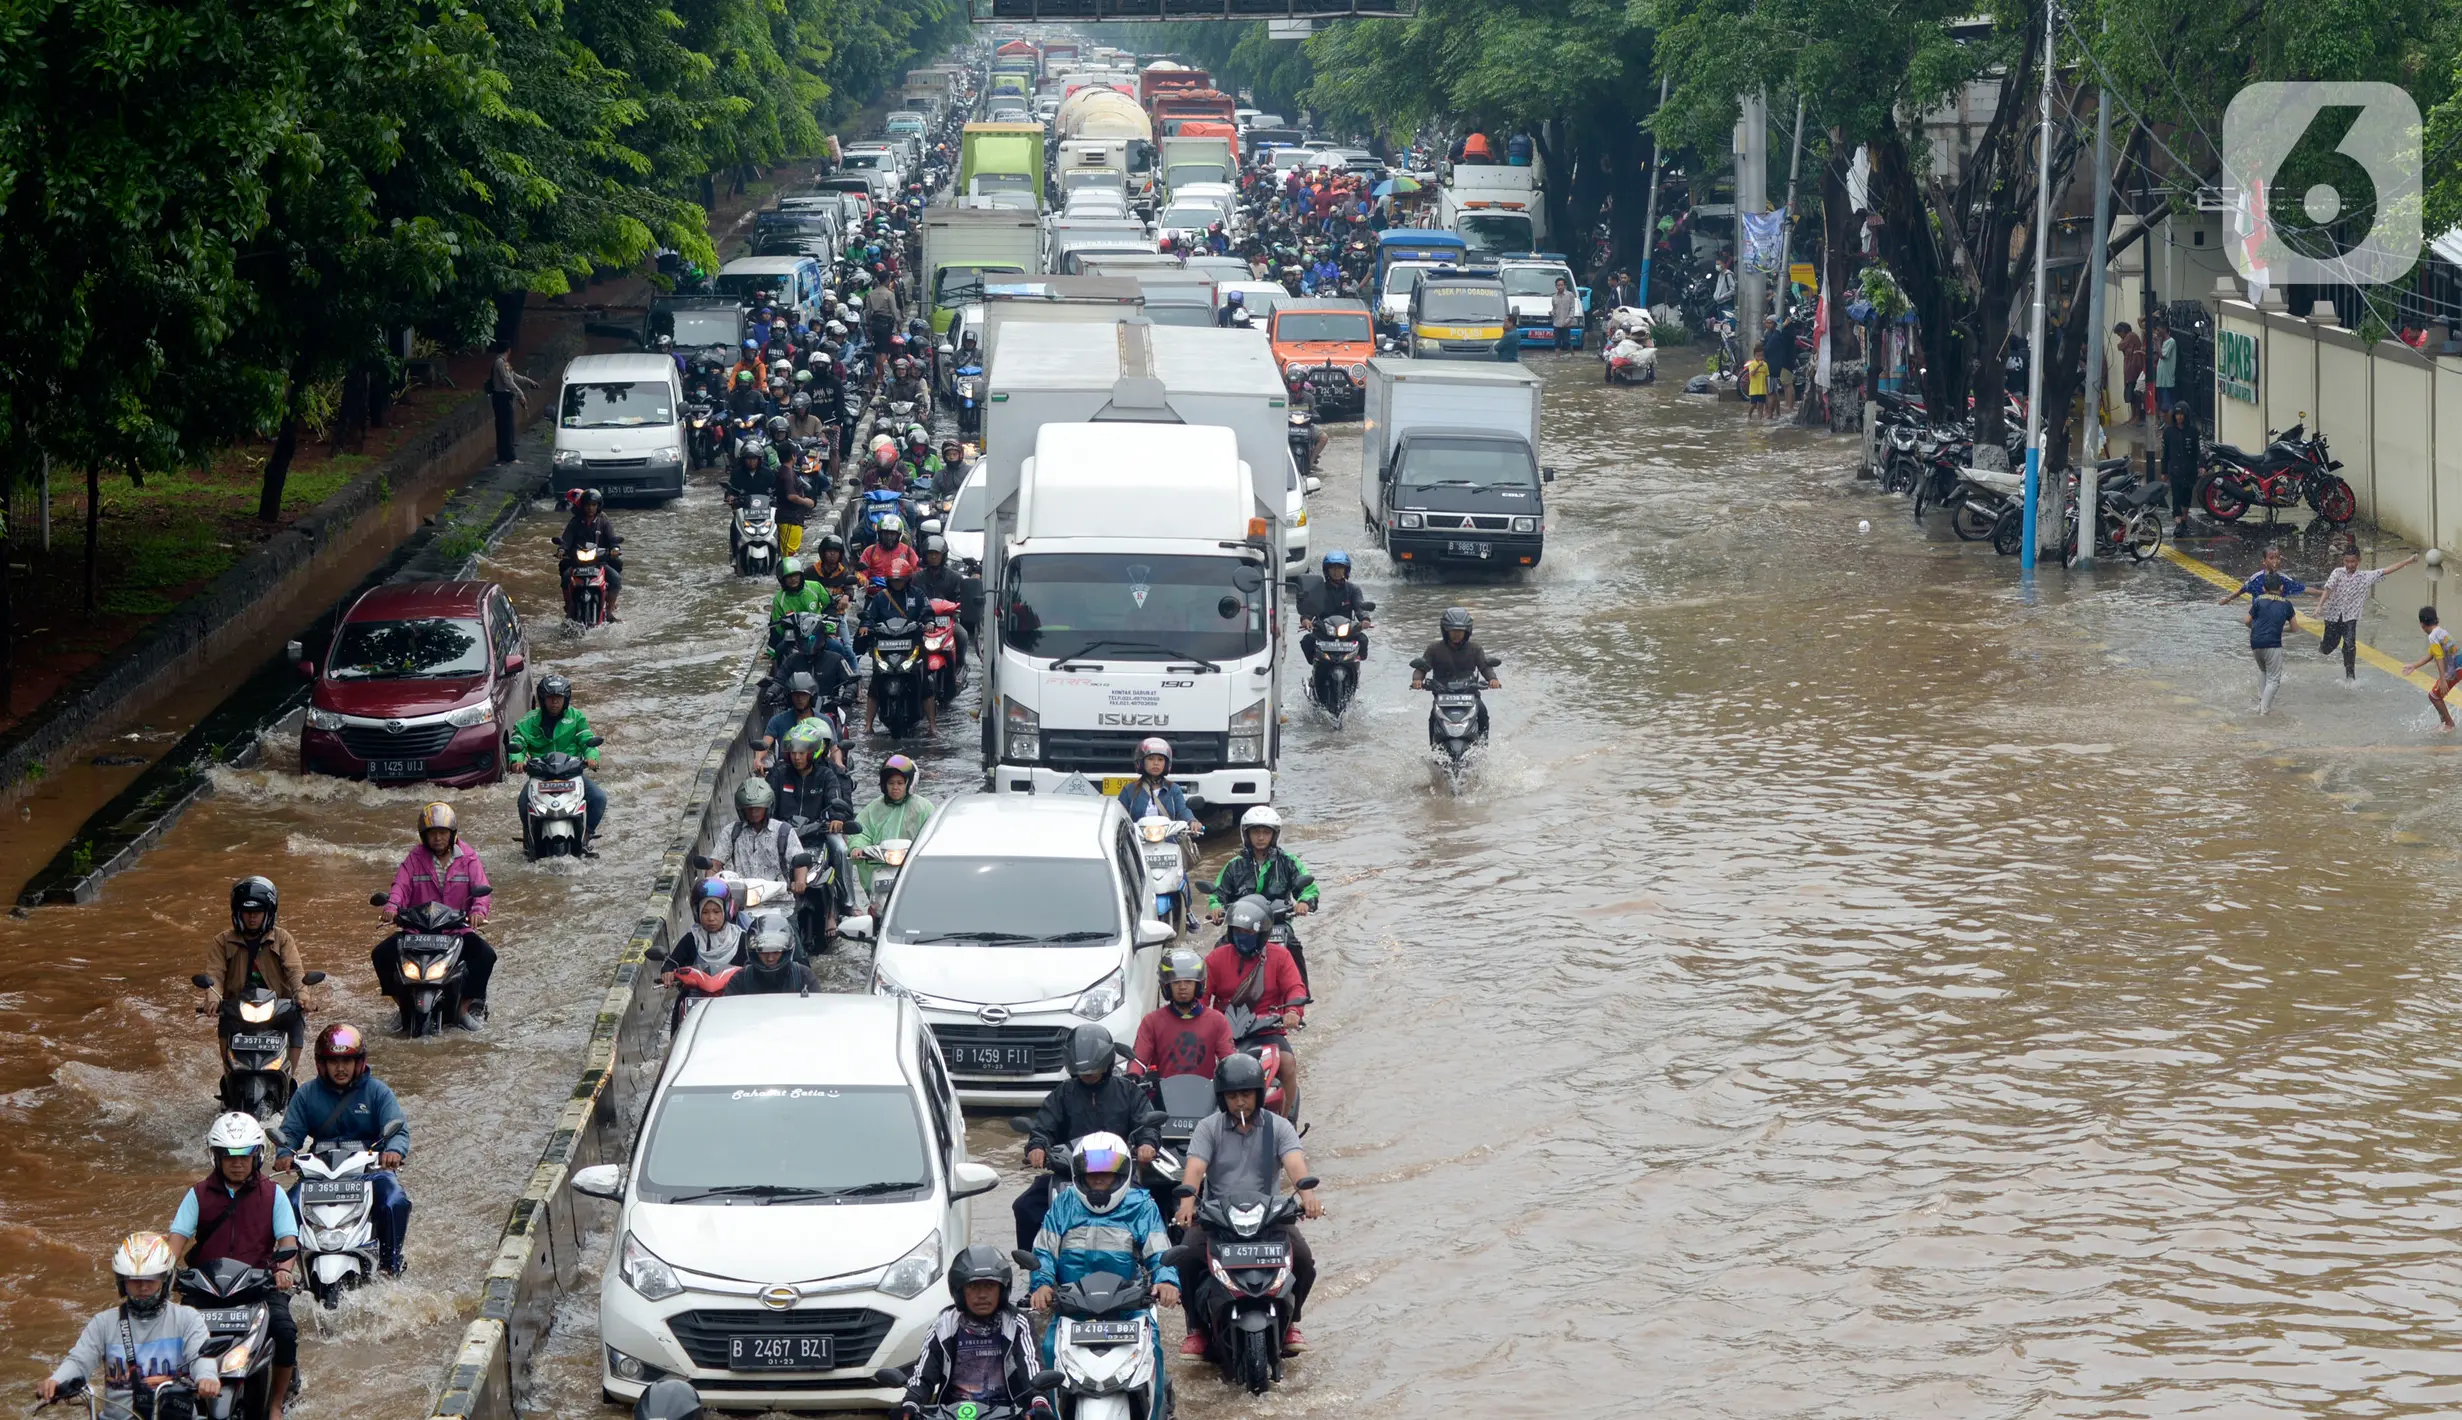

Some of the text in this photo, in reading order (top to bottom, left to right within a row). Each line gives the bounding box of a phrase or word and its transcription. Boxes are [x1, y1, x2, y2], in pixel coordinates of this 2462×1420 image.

[2227, 331, 2255, 384] PKB
[1161, 680, 1194, 688] 190
[1098, 712, 1169, 726] ISUZU
[370, 761, 423, 772] B 1425 UIJ
[1103, 779, 1109, 790] B
[956, 1048, 1028, 1064] B 1459 FII
[791, 1088, 825, 1099] Setia
[1172, 1119, 1193, 1129] 4006
[308, 1183, 361, 1192] B 3658 URC
[1224, 1246, 1281, 1257] B 4577 TNT
[230, 1312, 249, 1321] UEH
[1075, 1325, 1081, 1333] B
[1085, 1324, 1108, 1333] 4104
[732, 1339, 827, 1359] B 2467 BZI
